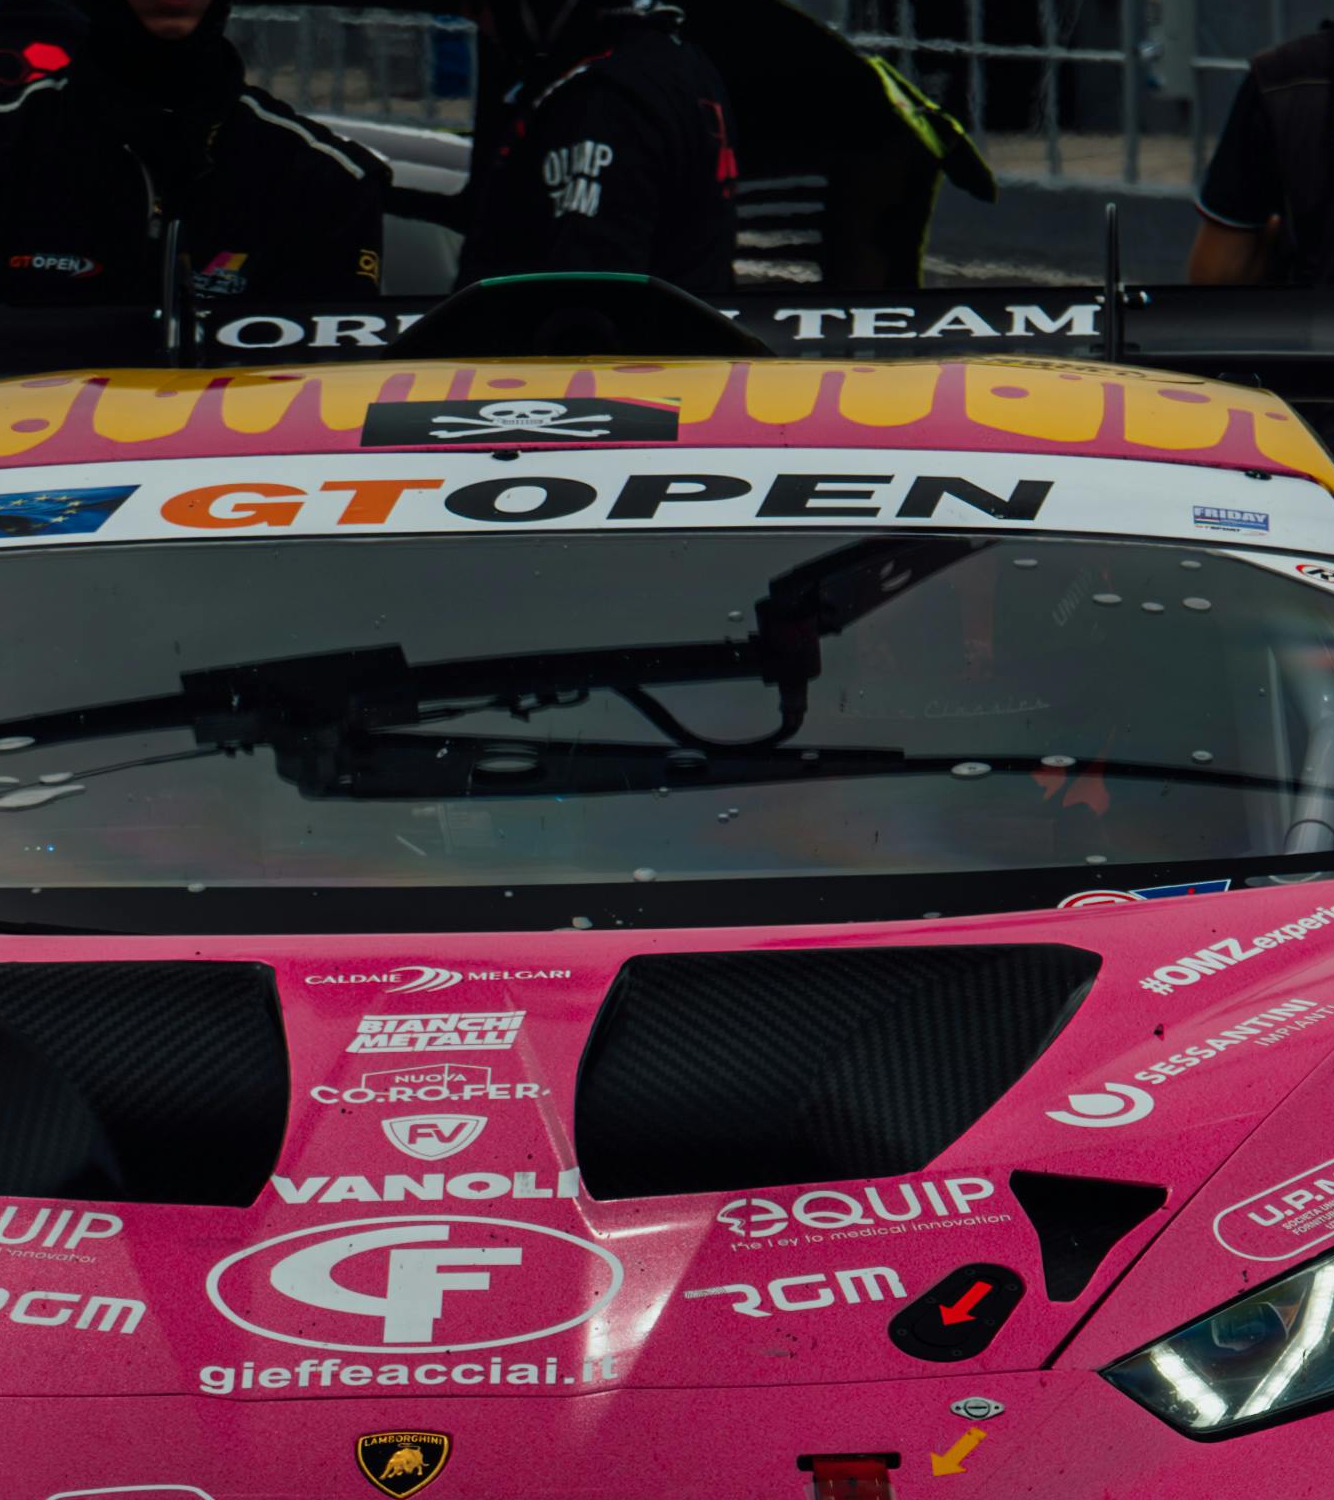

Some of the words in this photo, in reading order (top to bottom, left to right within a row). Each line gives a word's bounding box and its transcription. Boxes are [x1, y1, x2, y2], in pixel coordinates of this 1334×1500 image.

[773, 303, 1105, 341] TEAM
[1194, 506, 1268, 523] FRIDAY
[304, 971, 404, 985] CALDAIE
[468, 969, 571, 981] MELGARI
[356, 1011, 527, 1033] BIANCHI
[345, 1030, 519, 1053] METALLI
[1134, 998, 1318, 1085] SESSANTINI
[395, 1073, 467, 1084] NUOVA
[407, 1122, 469, 1145] FV
[270, 1168, 580, 1204] VANOLI
[805, 1232, 825, 1244] to
[831, 1222, 908, 1241] medical
[913, 1213, 1012, 1232] innovation
[198, 1353, 618, 1394] gieffeacciai.it
[364, 1434, 443, 1447] LAMBORGHINI
